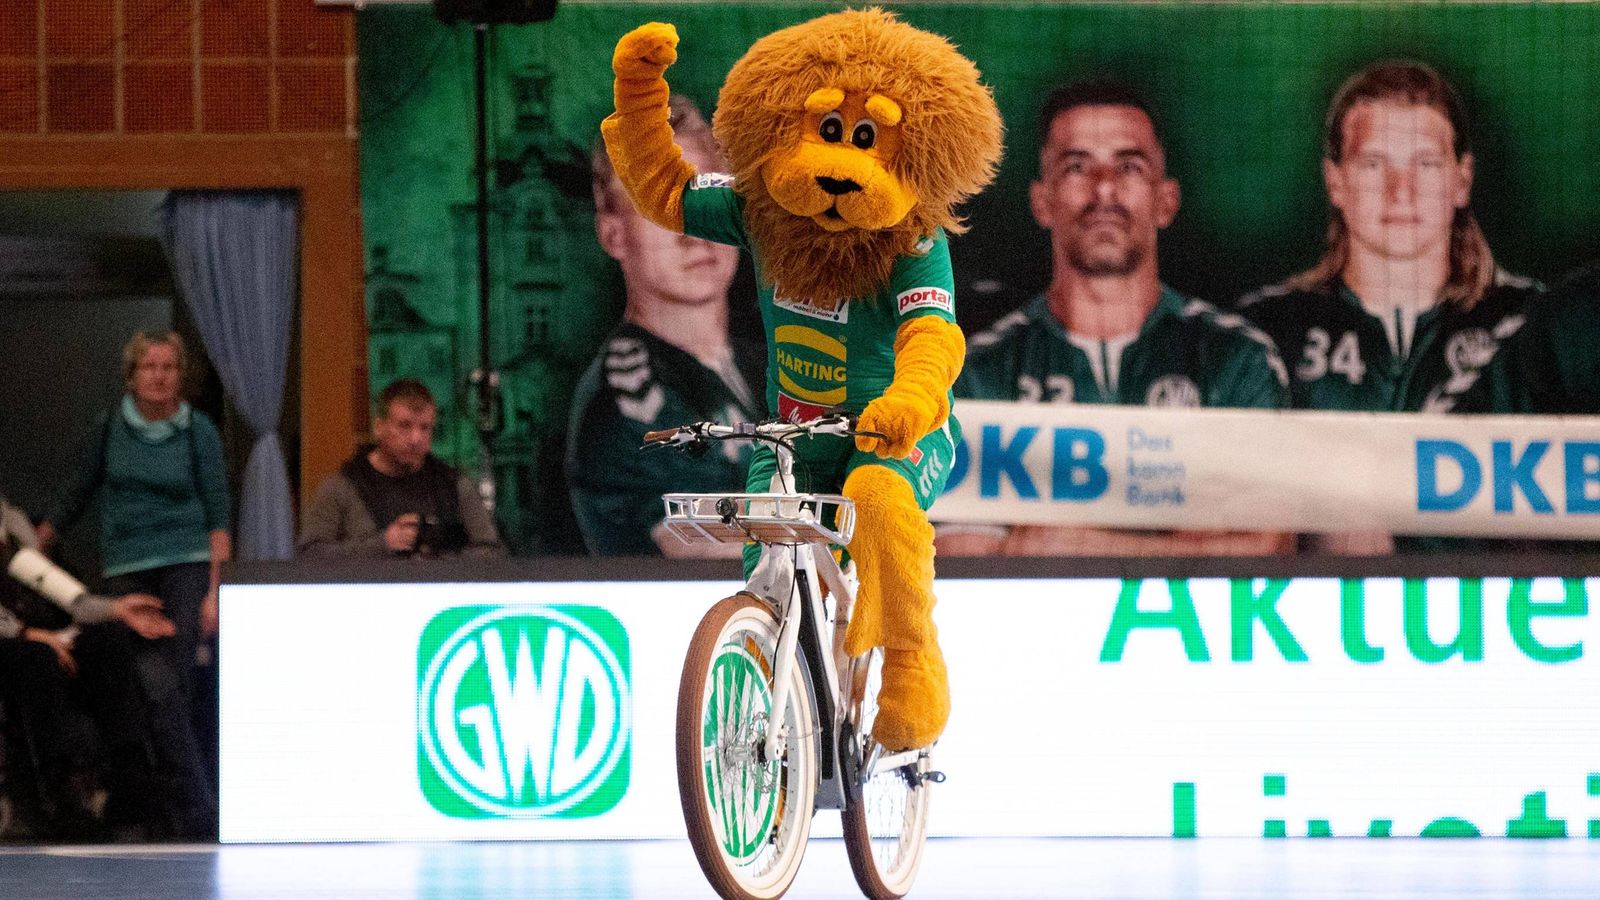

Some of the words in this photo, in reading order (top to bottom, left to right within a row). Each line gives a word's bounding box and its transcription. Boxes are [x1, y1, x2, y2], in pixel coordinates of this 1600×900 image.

[899, 289, 951, 311] porta!
[776, 347, 847, 383] HARTING
[1296, 326, 1366, 384] 34
[1416, 439, 1600, 514] DKB
[432, 625, 614, 805] GWD
